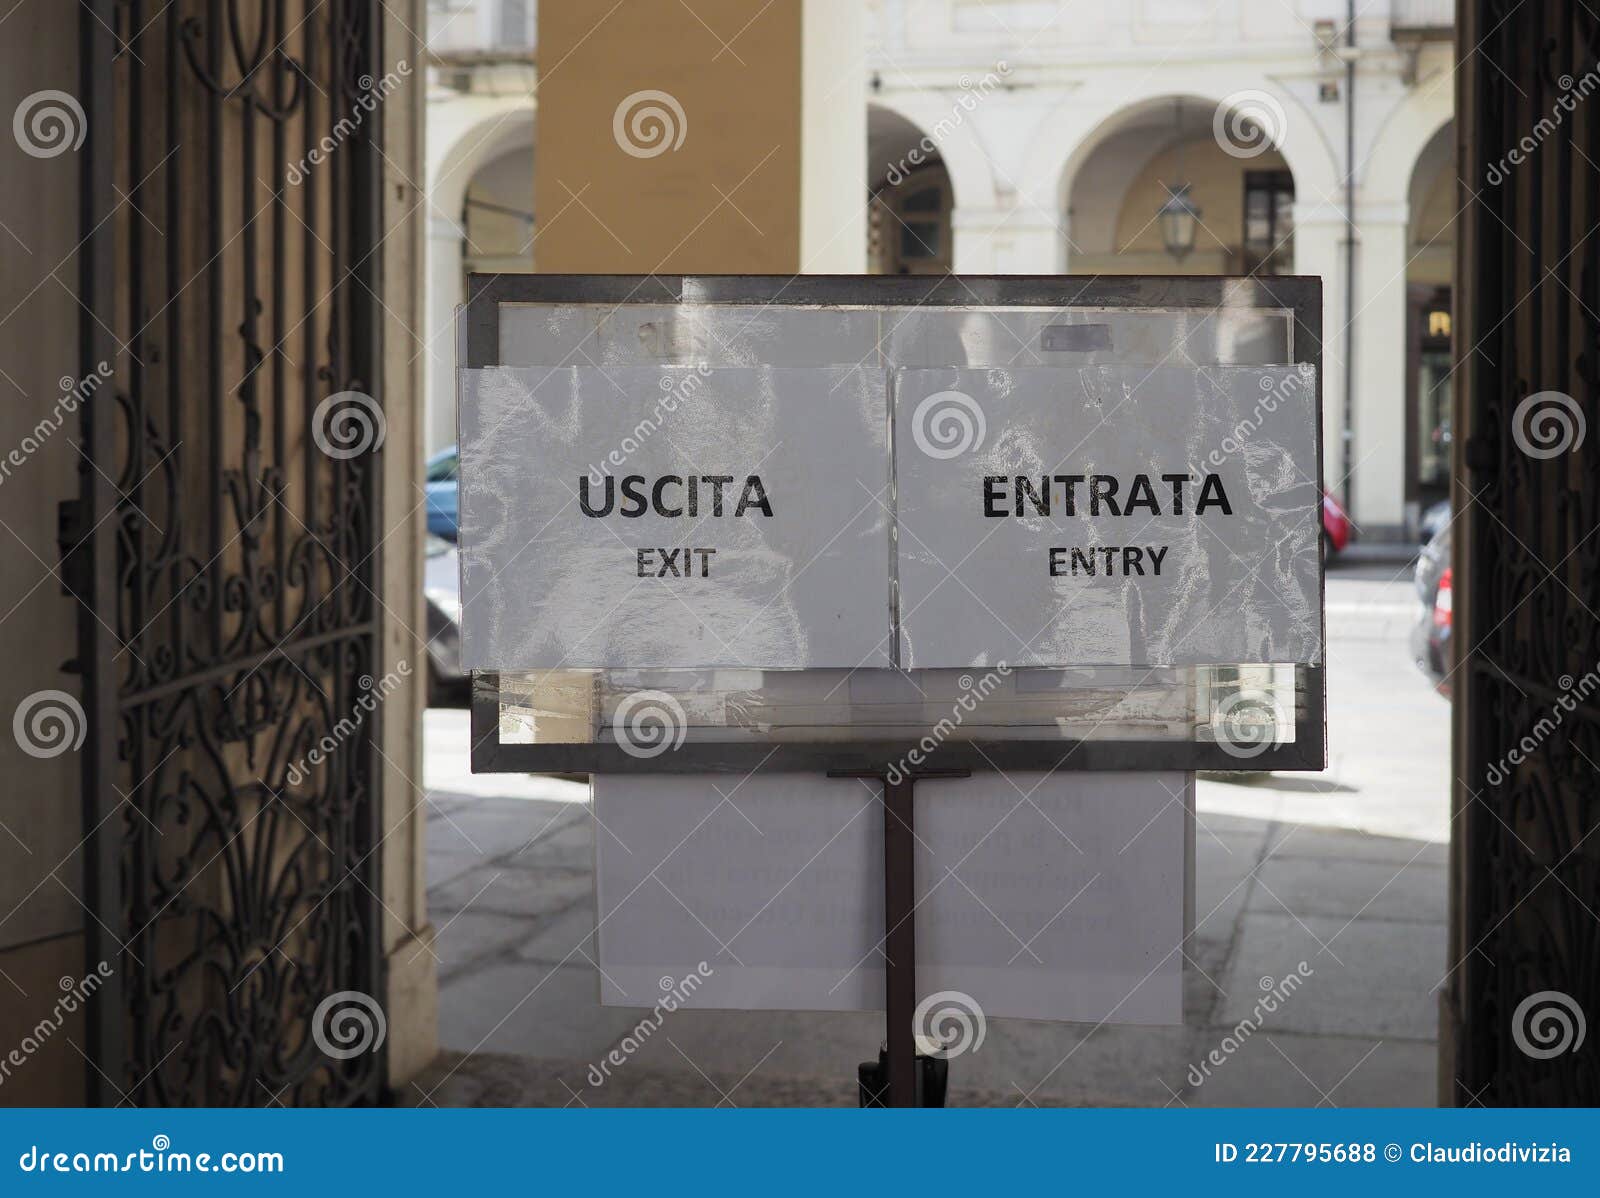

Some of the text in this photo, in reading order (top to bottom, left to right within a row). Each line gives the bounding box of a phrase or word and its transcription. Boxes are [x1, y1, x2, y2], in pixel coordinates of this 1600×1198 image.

[580, 475, 774, 518] USCITA
[983, 474, 1233, 517] ENTRATA
[637, 548, 717, 577] EXIT
[1049, 546, 1168, 576] ENTRY
